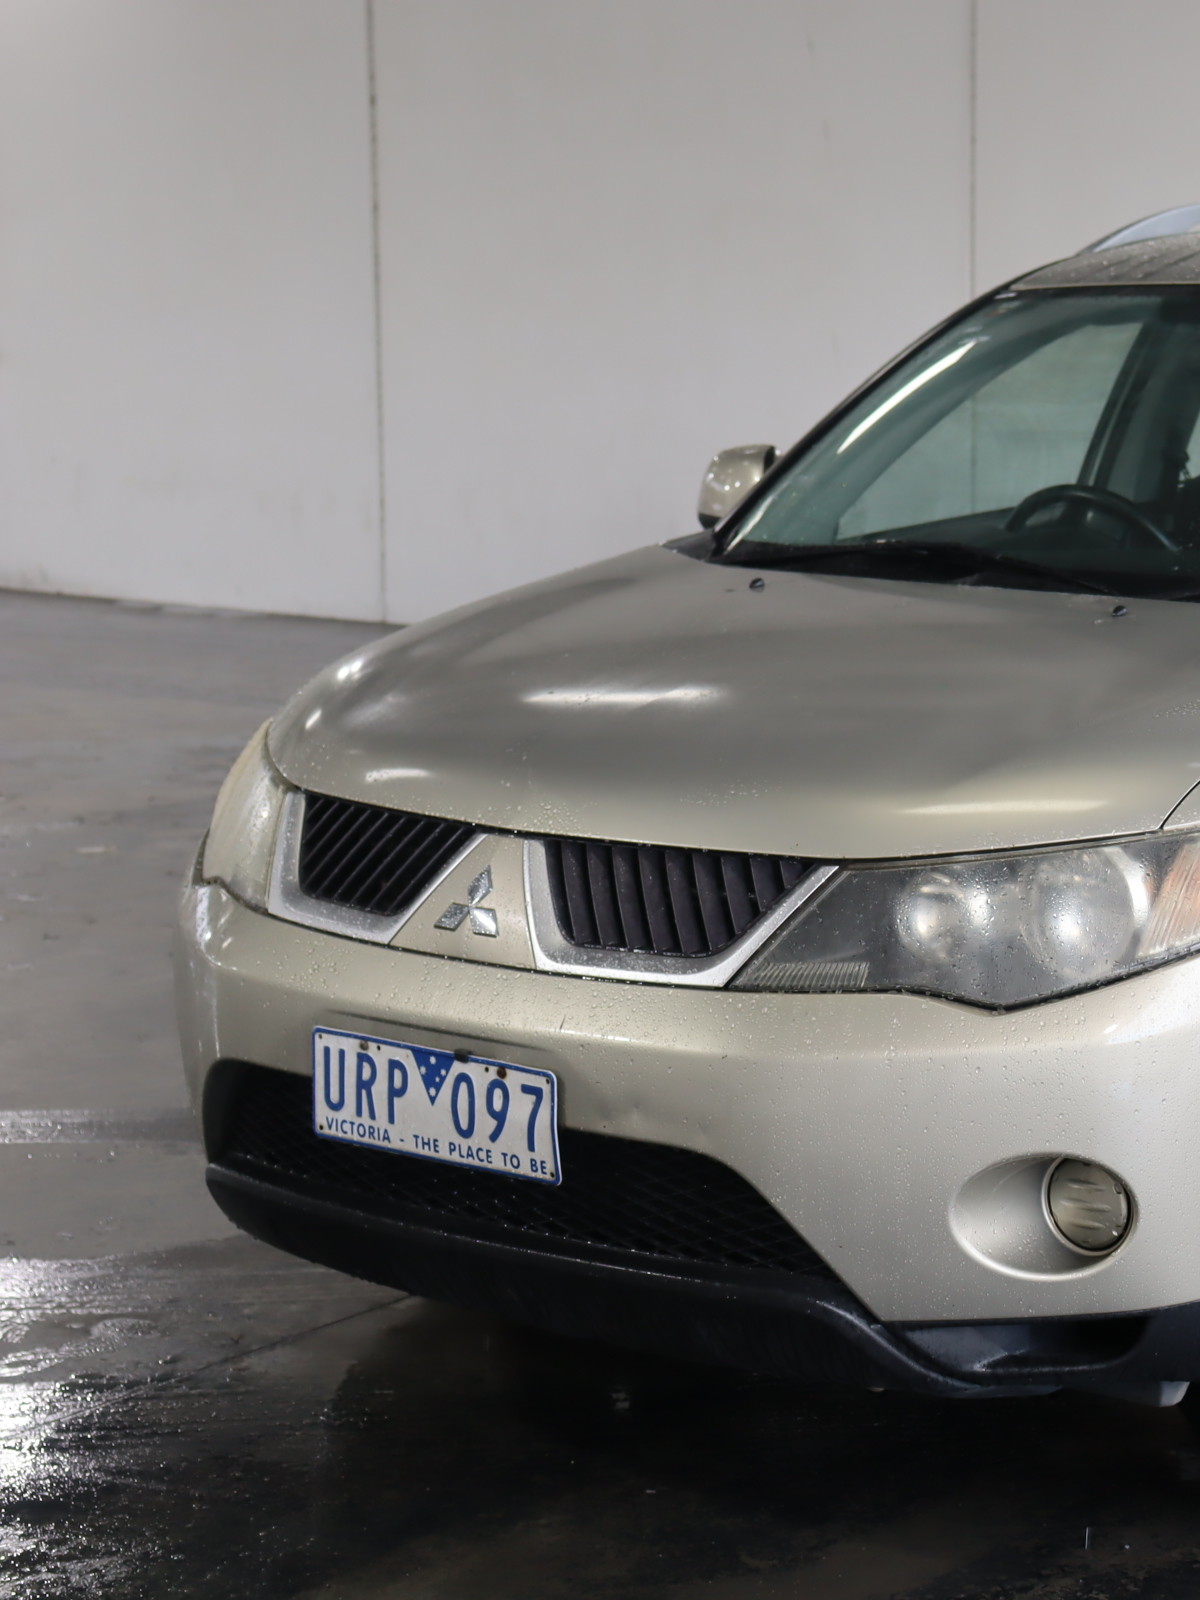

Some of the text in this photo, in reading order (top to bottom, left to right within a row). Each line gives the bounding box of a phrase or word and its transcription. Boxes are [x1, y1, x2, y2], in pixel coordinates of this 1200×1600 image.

[323, 1045, 544, 1153] URP 097
[325, 1116, 391, 1144] VICTORIA
[413, 1134, 440, 1154] THE
[449, 1141, 493, 1165] PLACE
[501, 1151, 521, 1170] TO
[530, 1159, 548, 1175] BE
